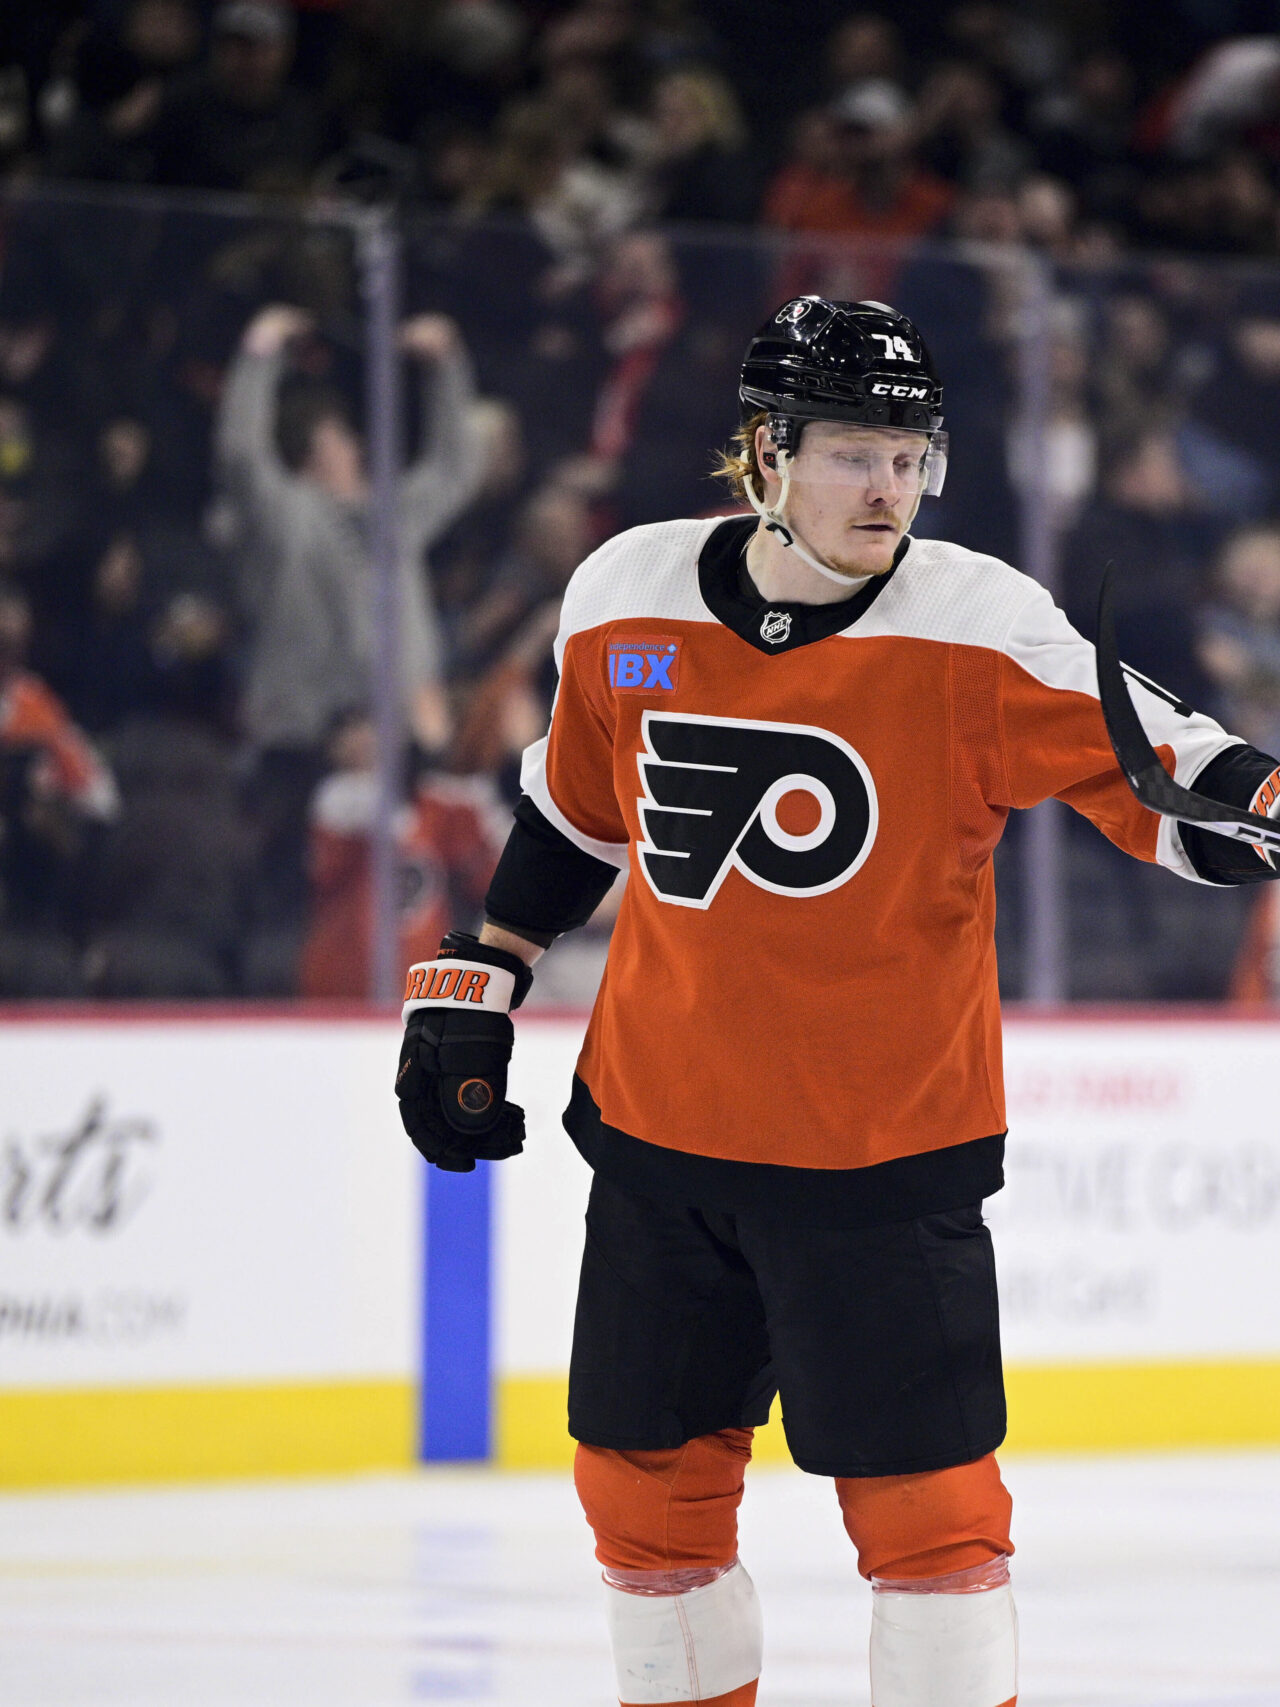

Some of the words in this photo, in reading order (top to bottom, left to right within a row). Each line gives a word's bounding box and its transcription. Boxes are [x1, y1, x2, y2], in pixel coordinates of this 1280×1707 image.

[871, 333, 914, 361] 74
[871, 383, 928, 400] CCM
[766, 620, 786, 635] NHL
[609, 653, 676, 690] IBX
